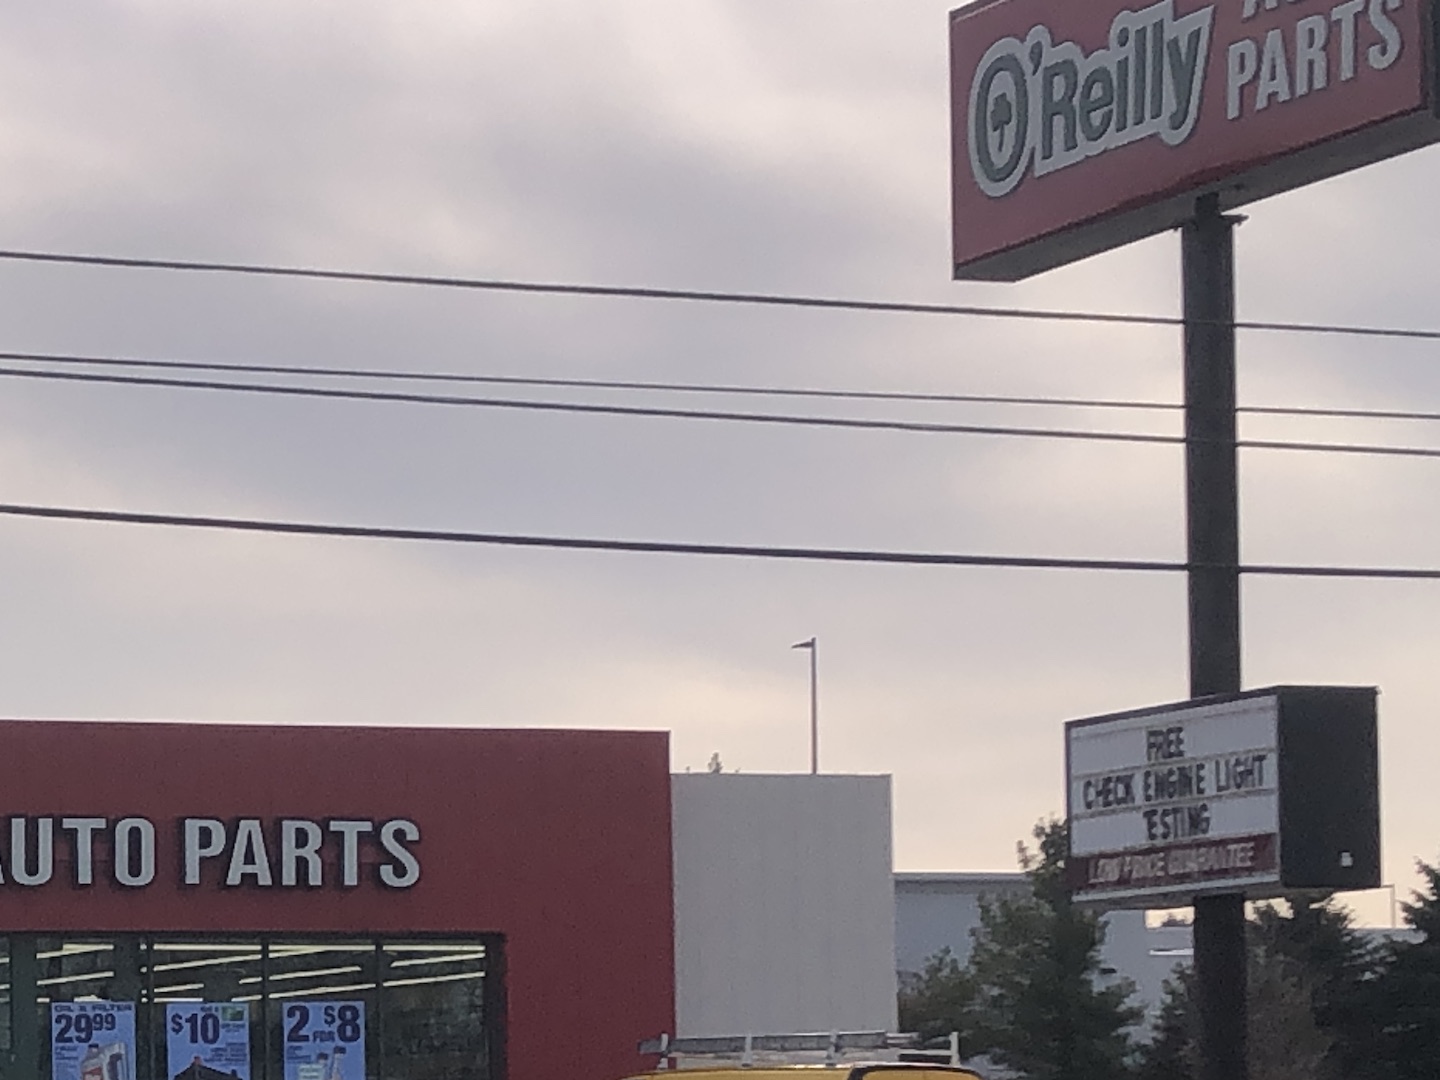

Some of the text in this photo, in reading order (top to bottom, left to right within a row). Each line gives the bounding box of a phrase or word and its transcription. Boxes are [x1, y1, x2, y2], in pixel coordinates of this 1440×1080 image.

[1226, 0, 1403, 120] PARTS
[970, 8, 1210, 192] O'Reilly
[1146, 727, 1185, 763] FREE
[1082, 754, 1267, 810] CHECK ENGINE LIGHT
[1142, 801, 1211, 841] TESTING
[183, 817, 423, 889] PARTS
[171, 1012, 220, 1045] $10
[286, 1004, 310, 1043] 2
